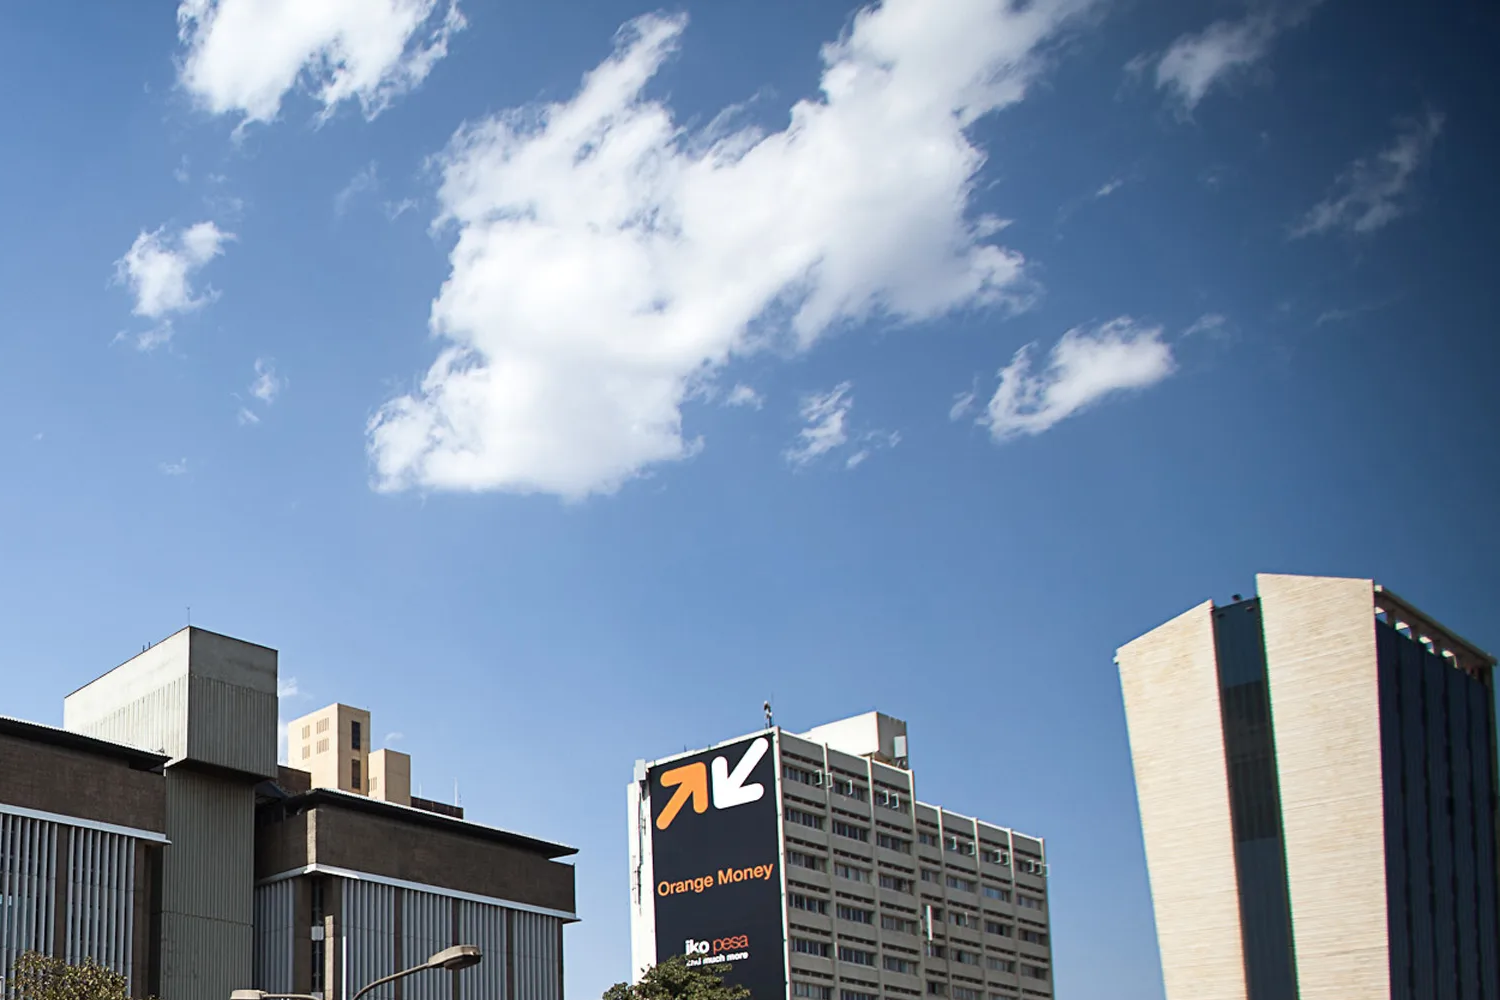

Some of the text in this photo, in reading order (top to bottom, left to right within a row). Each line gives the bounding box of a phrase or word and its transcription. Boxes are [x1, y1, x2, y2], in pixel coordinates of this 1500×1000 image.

[657, 863, 774, 896] Orange Money
[685, 934, 749, 955] iko pesa
[703, 954, 726, 965] much
[727, 951, 749, 962] more
